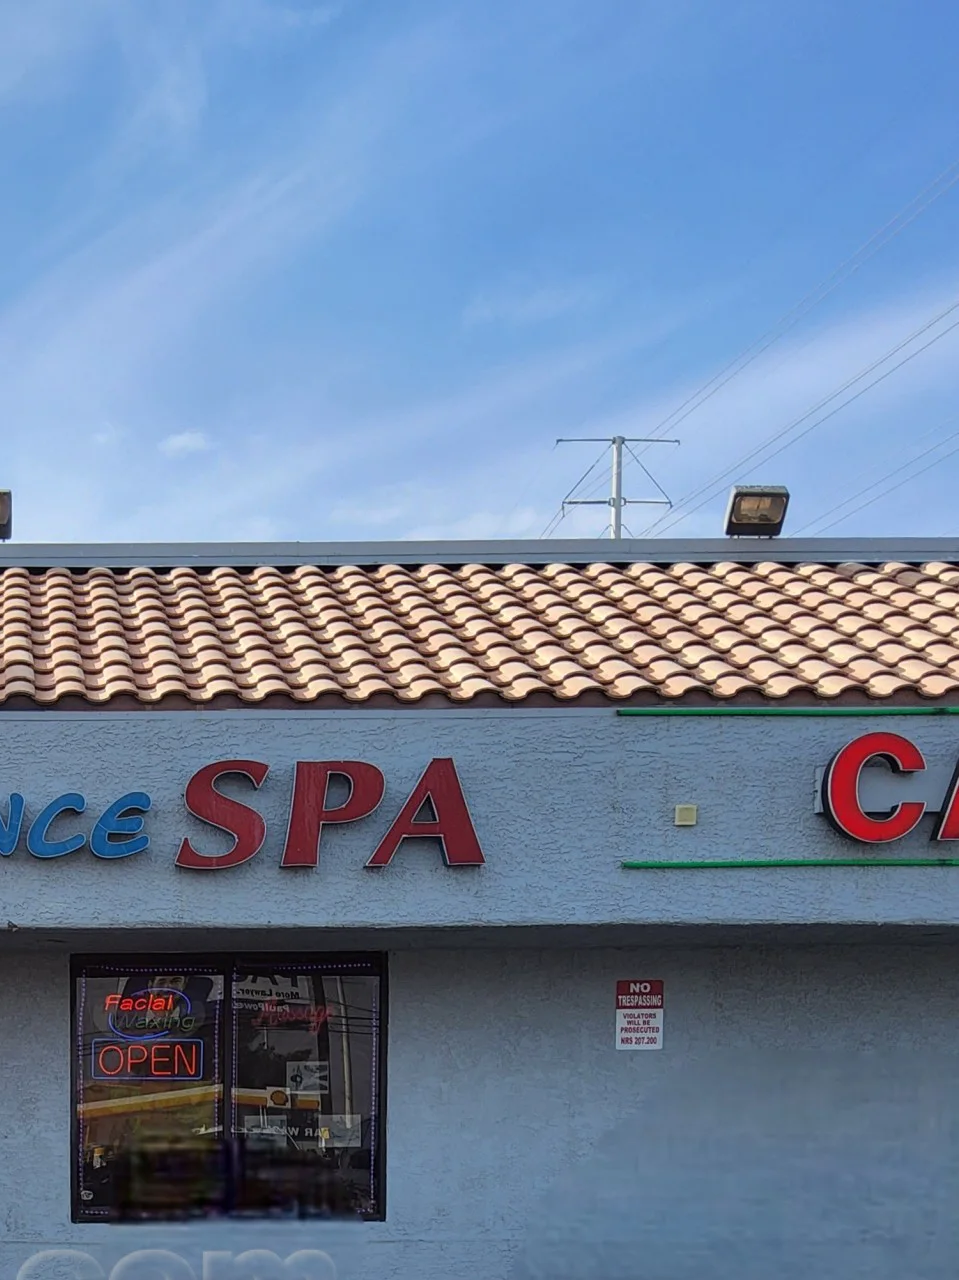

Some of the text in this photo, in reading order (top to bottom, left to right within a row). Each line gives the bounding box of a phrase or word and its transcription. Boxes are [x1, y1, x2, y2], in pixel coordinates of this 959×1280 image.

[823, 731, 959, 844] C
[175, 757, 486, 870] SPA
[629, 982, 651, 993] NO
[104, 993, 174, 1012] Facial
[618, 994, 662, 1006] TRESPASSING
[111, 1012, 196, 1032] Waxing
[620, 1026, 660, 1034] PROSECUTED
[620, 1036, 633, 1045] NRS
[98, 1044, 197, 1076] OPEN
